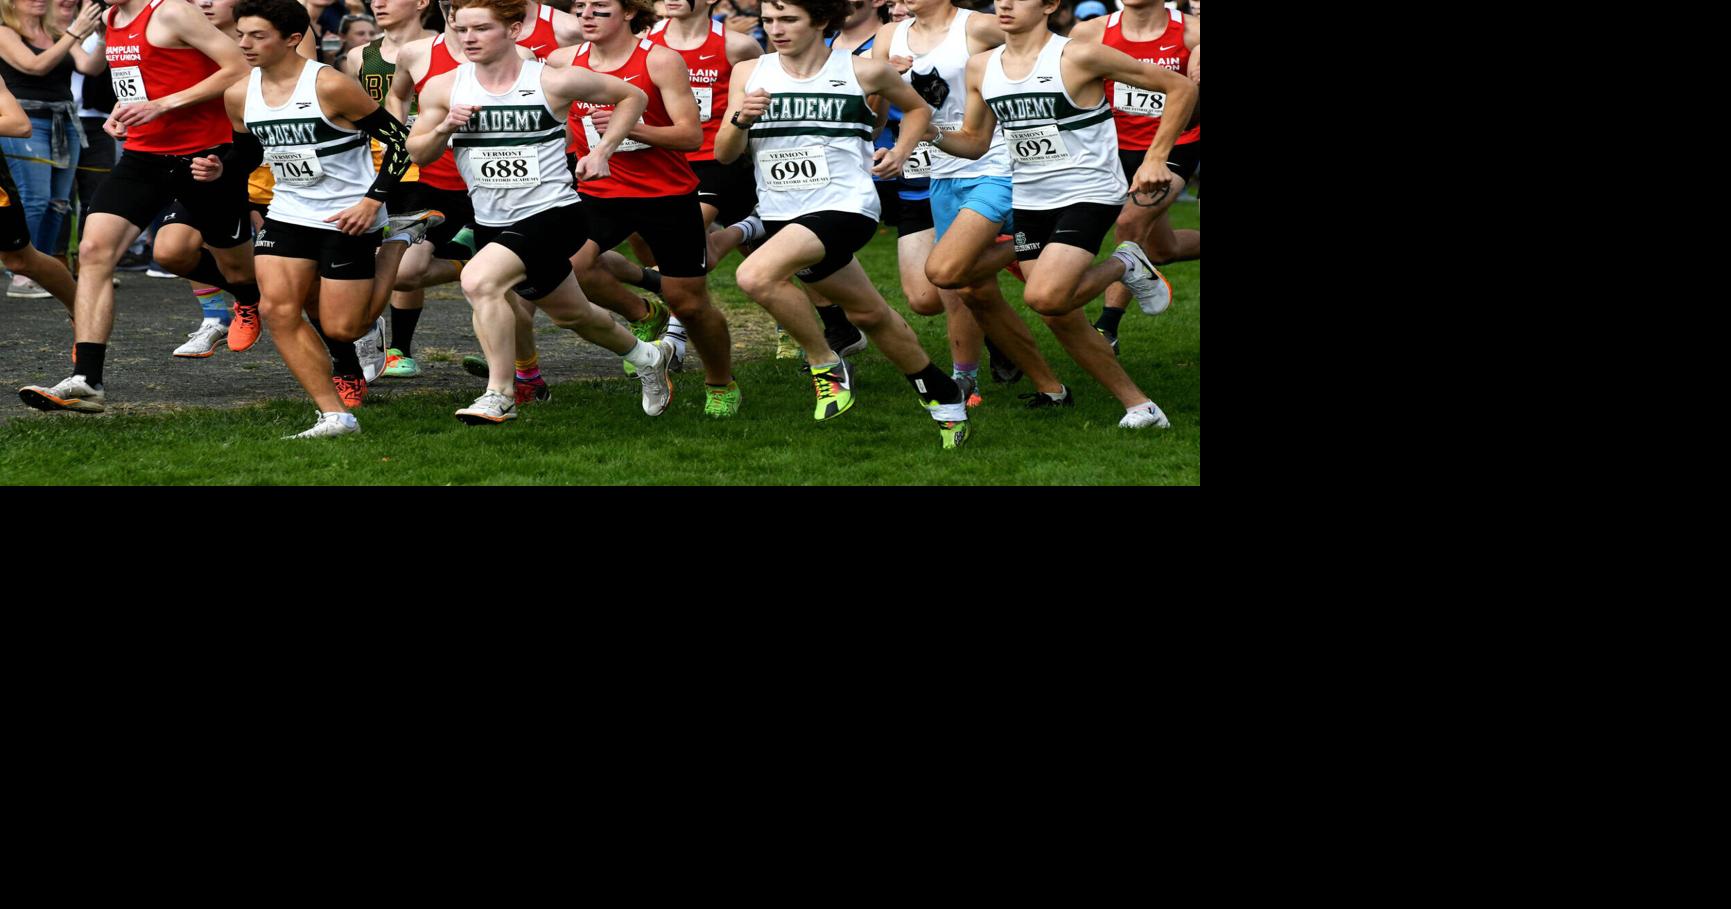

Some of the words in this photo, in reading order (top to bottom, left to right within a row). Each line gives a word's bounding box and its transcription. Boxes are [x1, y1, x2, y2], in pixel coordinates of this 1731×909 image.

[105, 45, 139, 54] AMPLAIN
[114, 79, 137, 97] 185
[1125, 92, 1163, 109] 178
[459, 109, 542, 132] CADEMY
[1016, 139, 1056, 157] 692
[274, 161, 314, 178] 704
[481, 159, 528, 178] 688
[771, 160, 816, 180] 690
